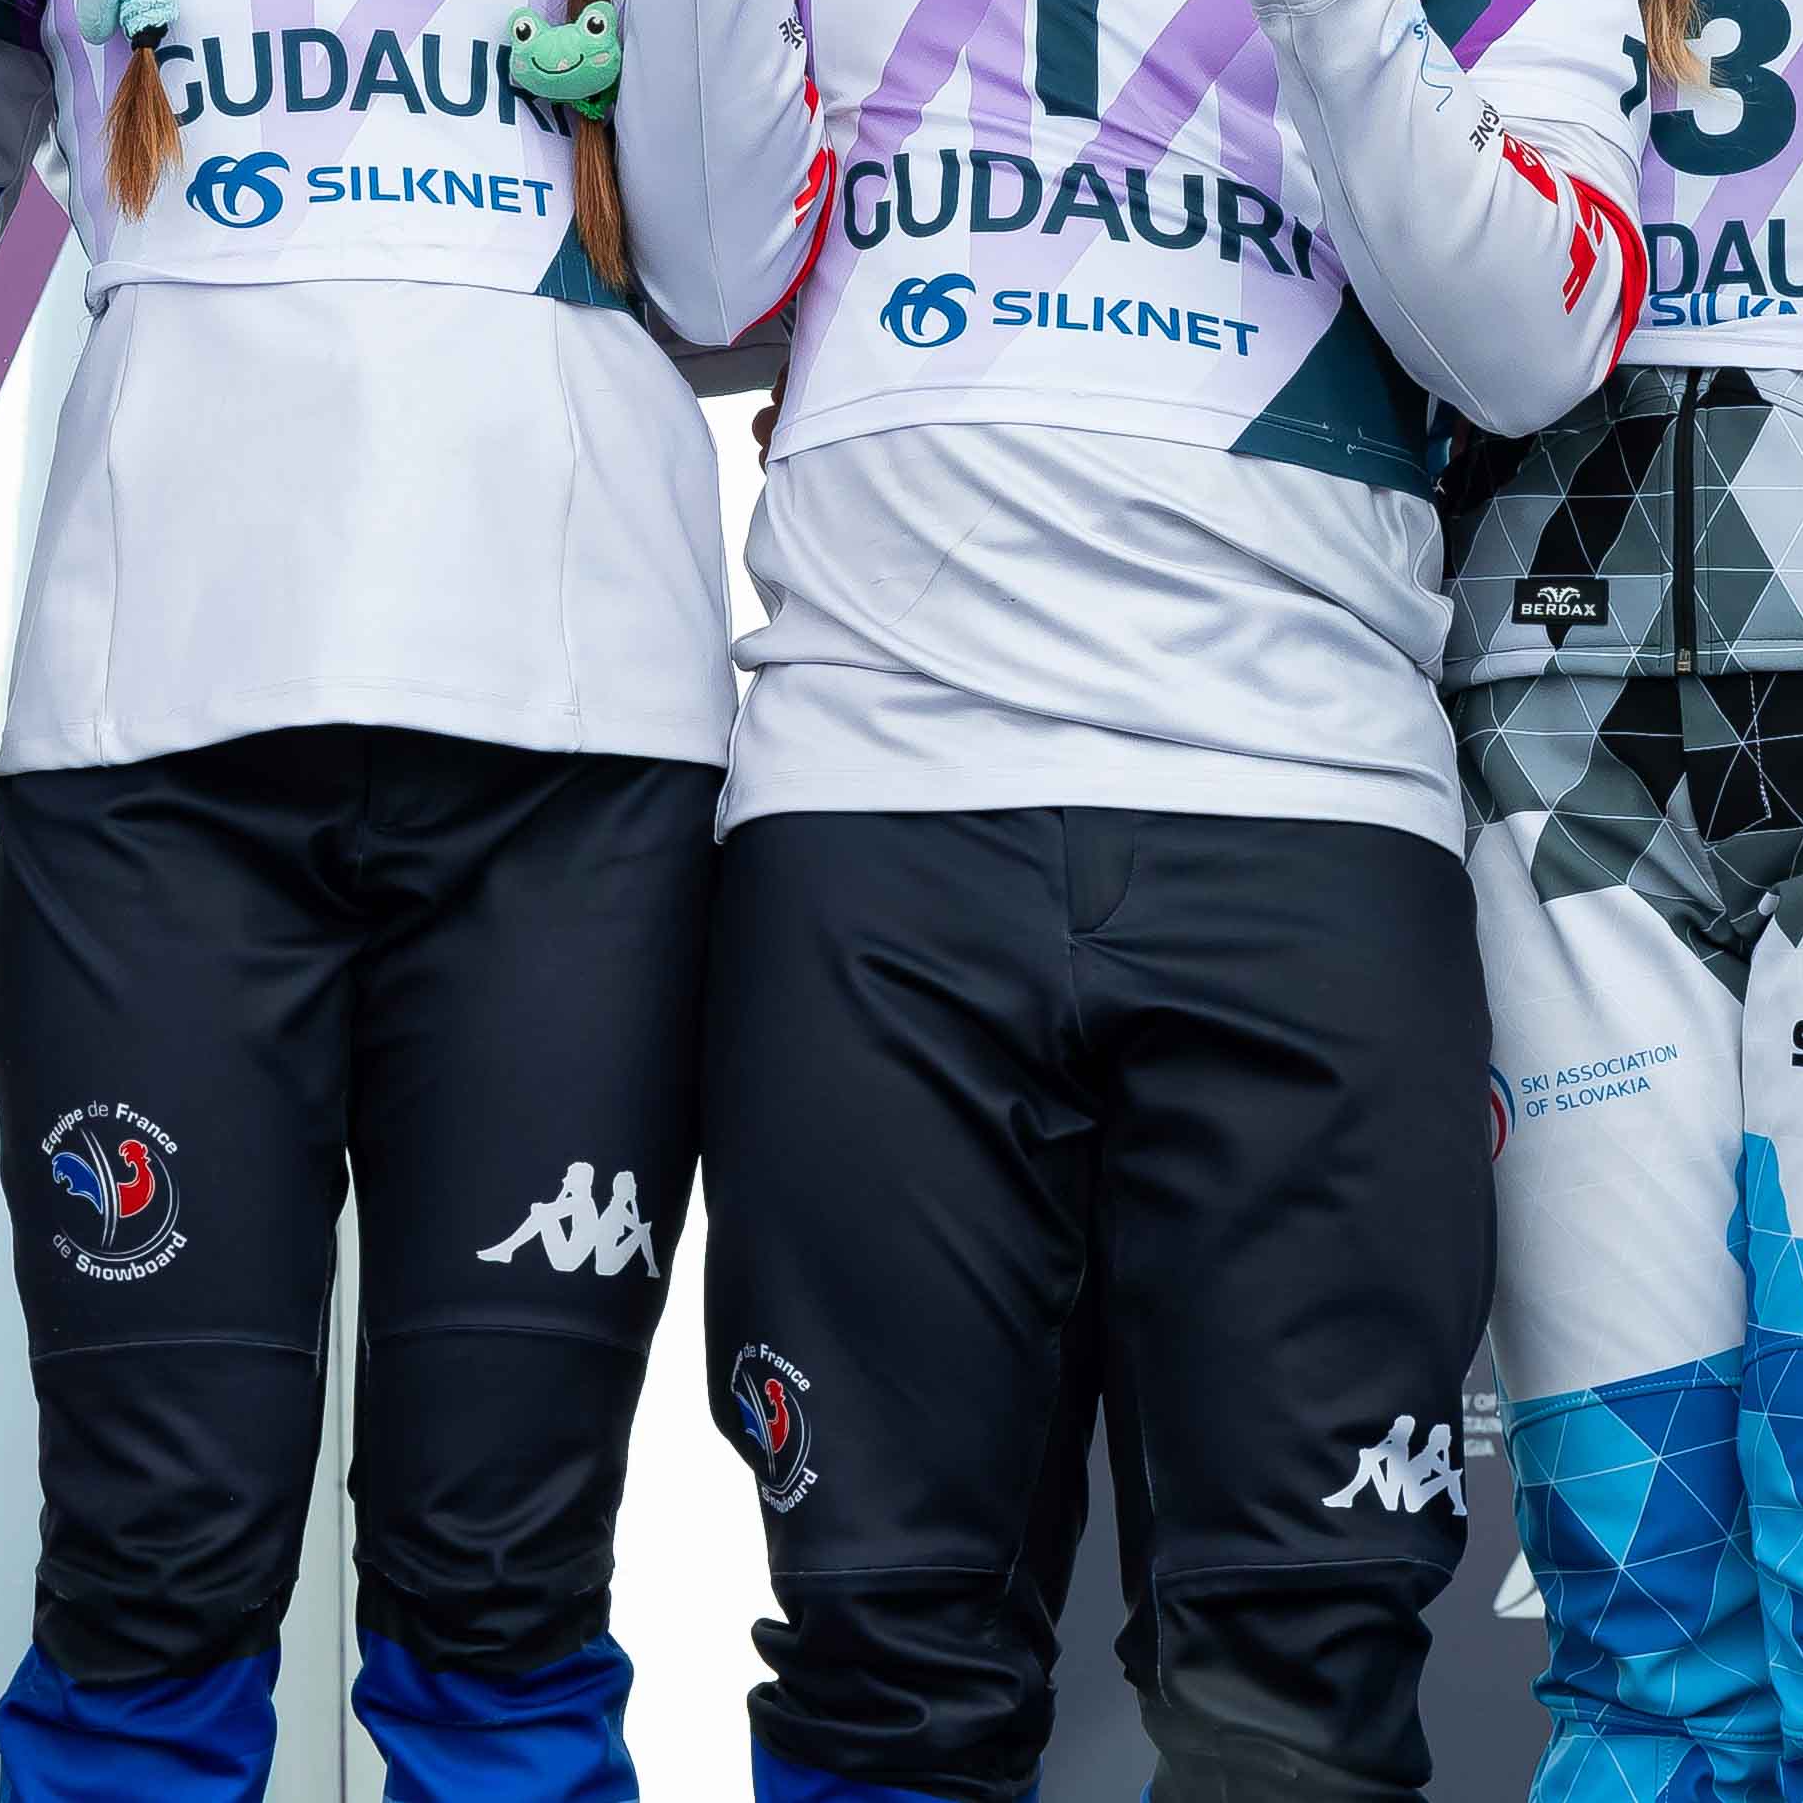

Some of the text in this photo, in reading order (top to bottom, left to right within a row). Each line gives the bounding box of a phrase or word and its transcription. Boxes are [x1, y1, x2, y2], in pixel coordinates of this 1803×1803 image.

[307, 165, 554, 217] SILKNET
[843, 148, 1317, 282] GUDAURI
[992, 290, 1260, 357] SILKNET
[1520, 603, 1597, 617] BERDAX
[1520, 1044, 1679, 1095] SKI ASSOCIATION
[1526, 1075, 1651, 1118] OF SLOVAKIA
[41, 1099, 178, 1156] Equipe de France
[52, 1230, 188, 1282] de Snowboard
[759, 1343, 811, 1393] France
